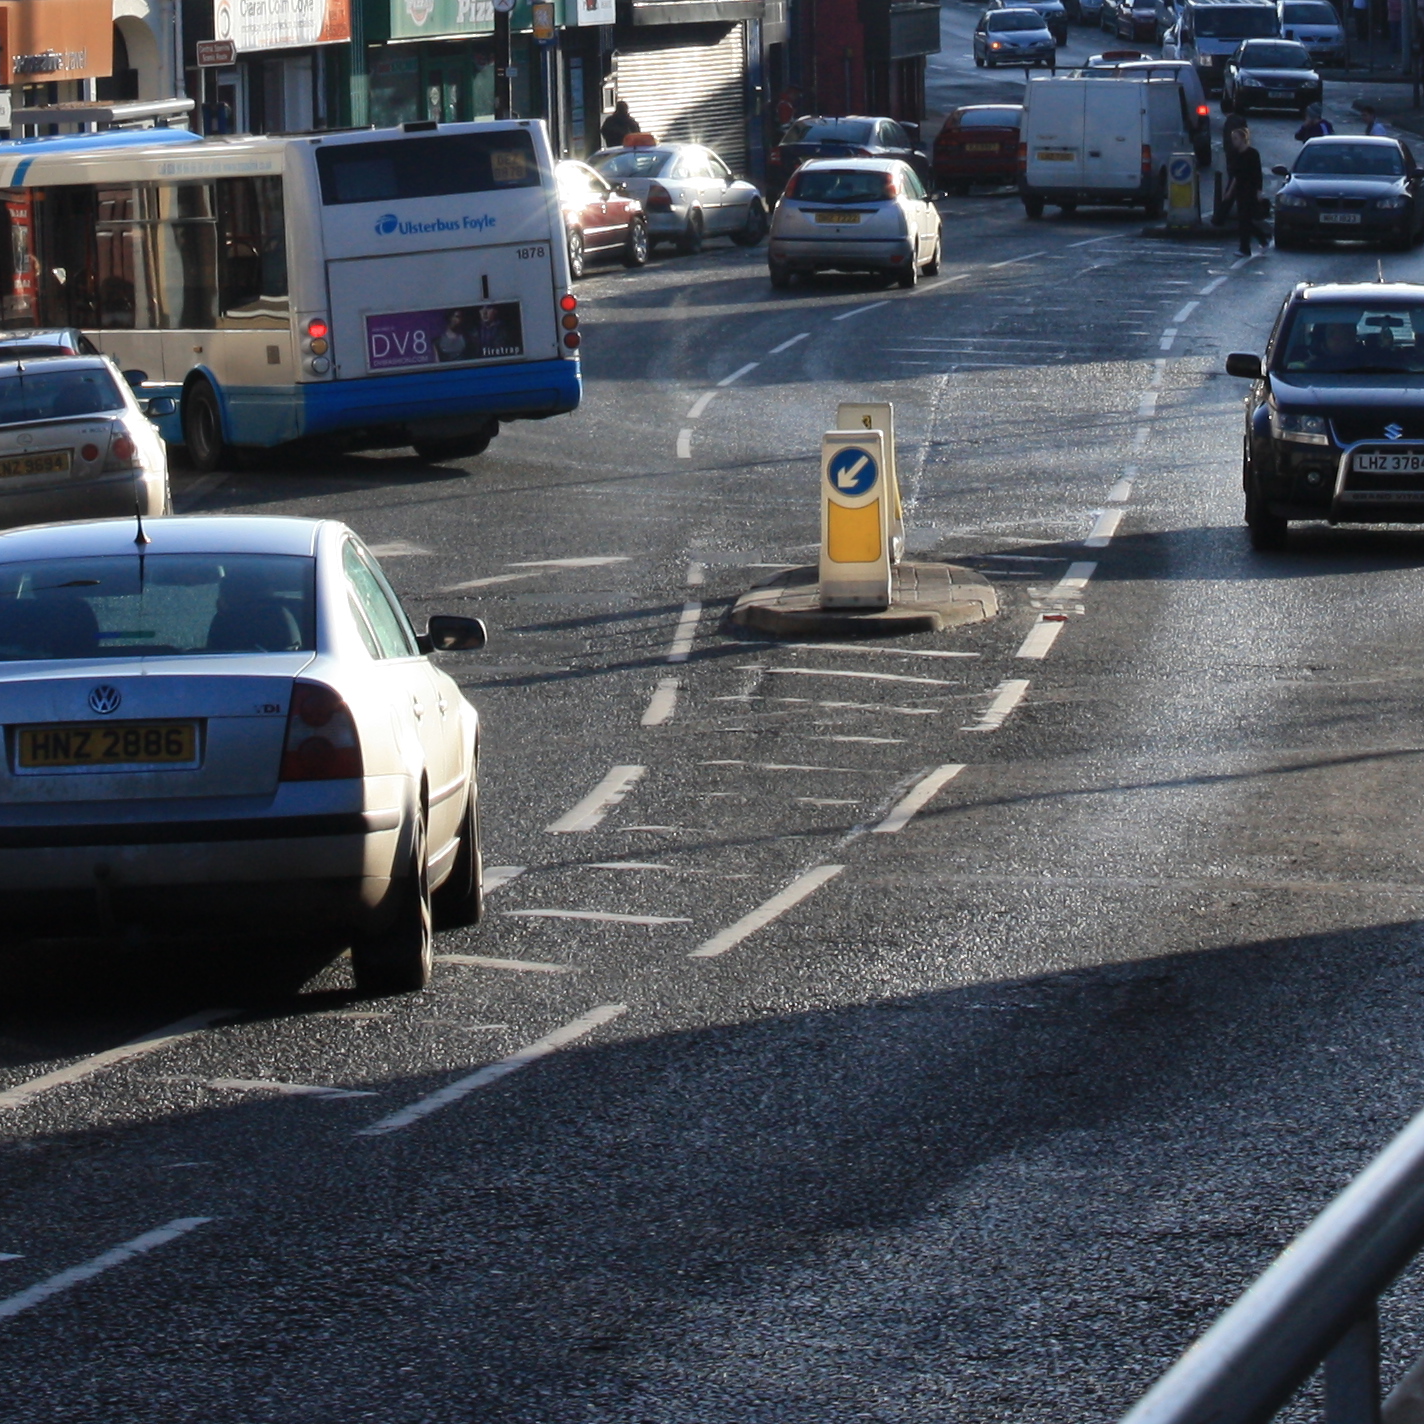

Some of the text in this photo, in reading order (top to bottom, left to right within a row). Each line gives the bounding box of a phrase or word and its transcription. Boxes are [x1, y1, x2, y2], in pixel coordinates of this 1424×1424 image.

[399, 214, 496, 235] Ulsterbus Foyle
[516, 247, 545, 260] 1878
[371, 329, 426, 358] DV8
[25, 456, 64, 475] 9694
[1359, 456, 1388, 470] LHZ
[31, 732, 91, 760] HNZ
